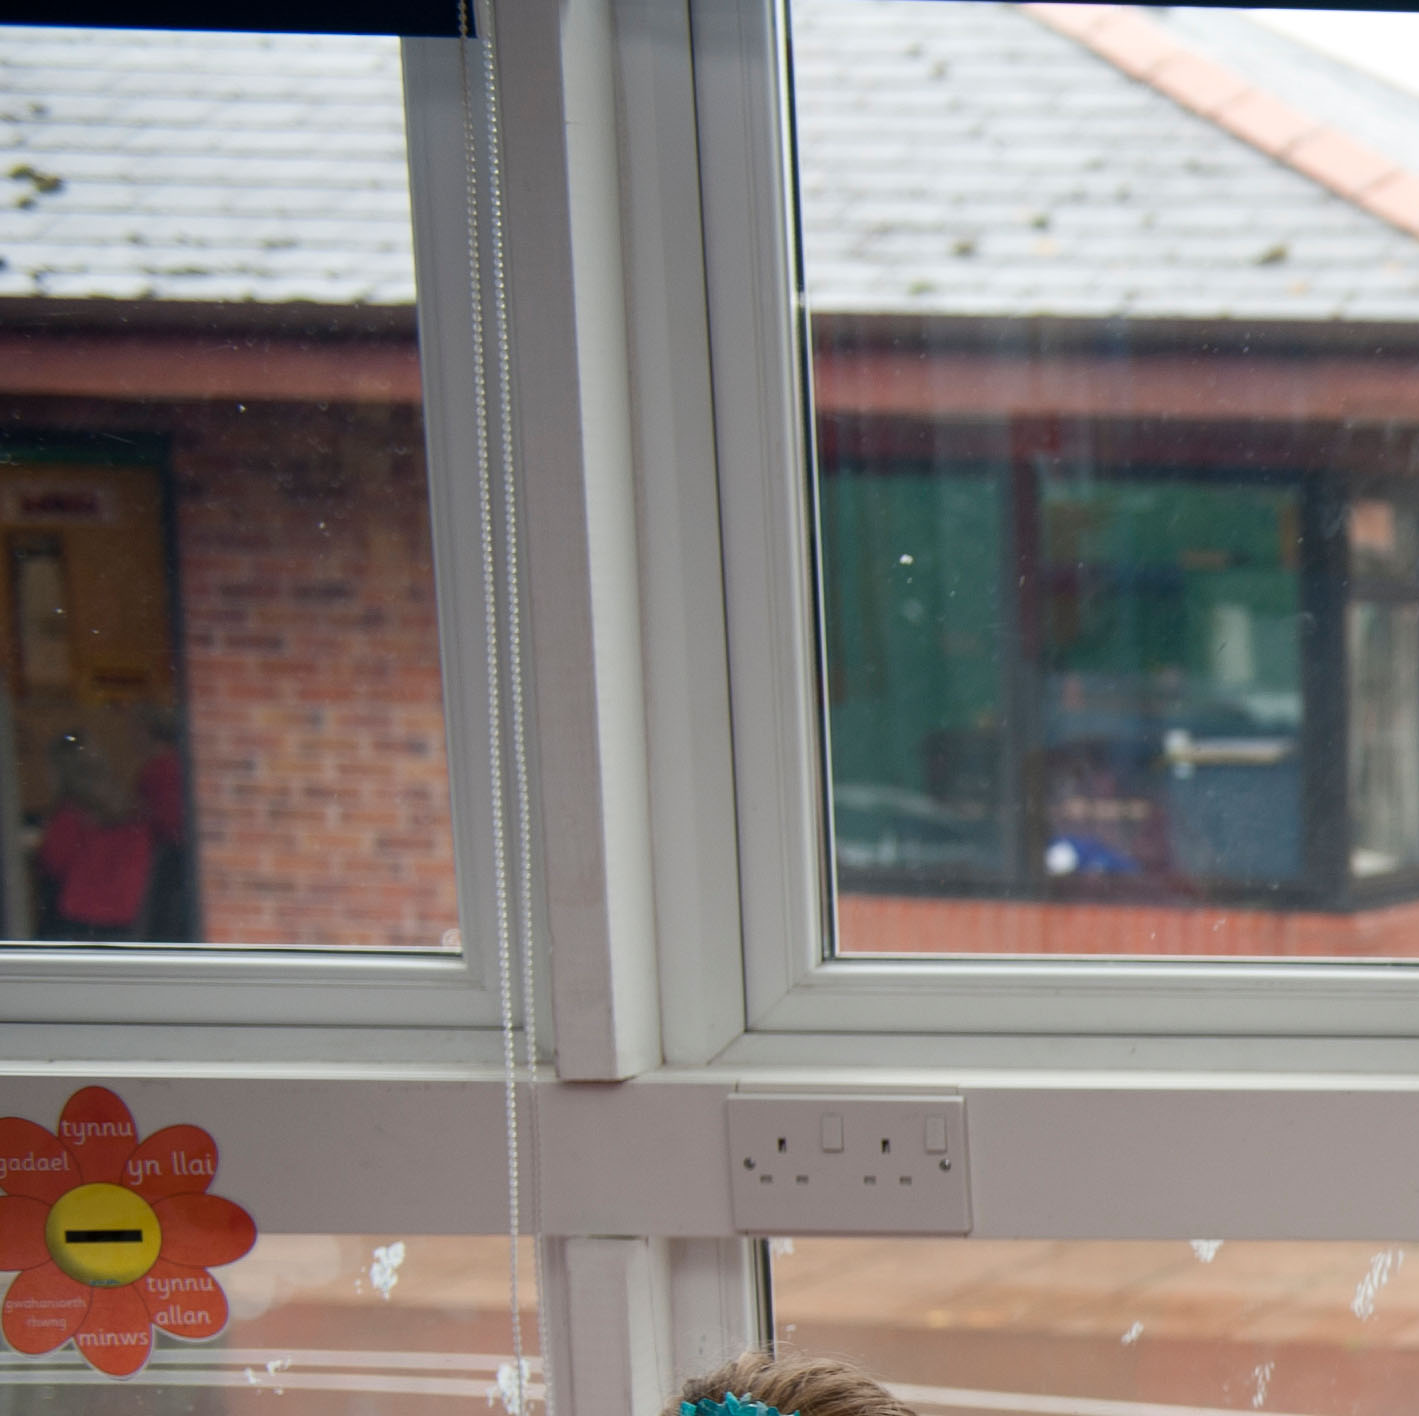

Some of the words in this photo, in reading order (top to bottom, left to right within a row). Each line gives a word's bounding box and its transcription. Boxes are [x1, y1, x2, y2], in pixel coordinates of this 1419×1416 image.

[60, 1119, 134, 1145] tynnu
[126, 1158, 162, 1185] yn
[172, 1150, 215, 1176] llai
[146, 1275, 215, 1300] tynnu
[154, 1305, 212, 1326] allan
[78, 1329, 149, 1348] minws
